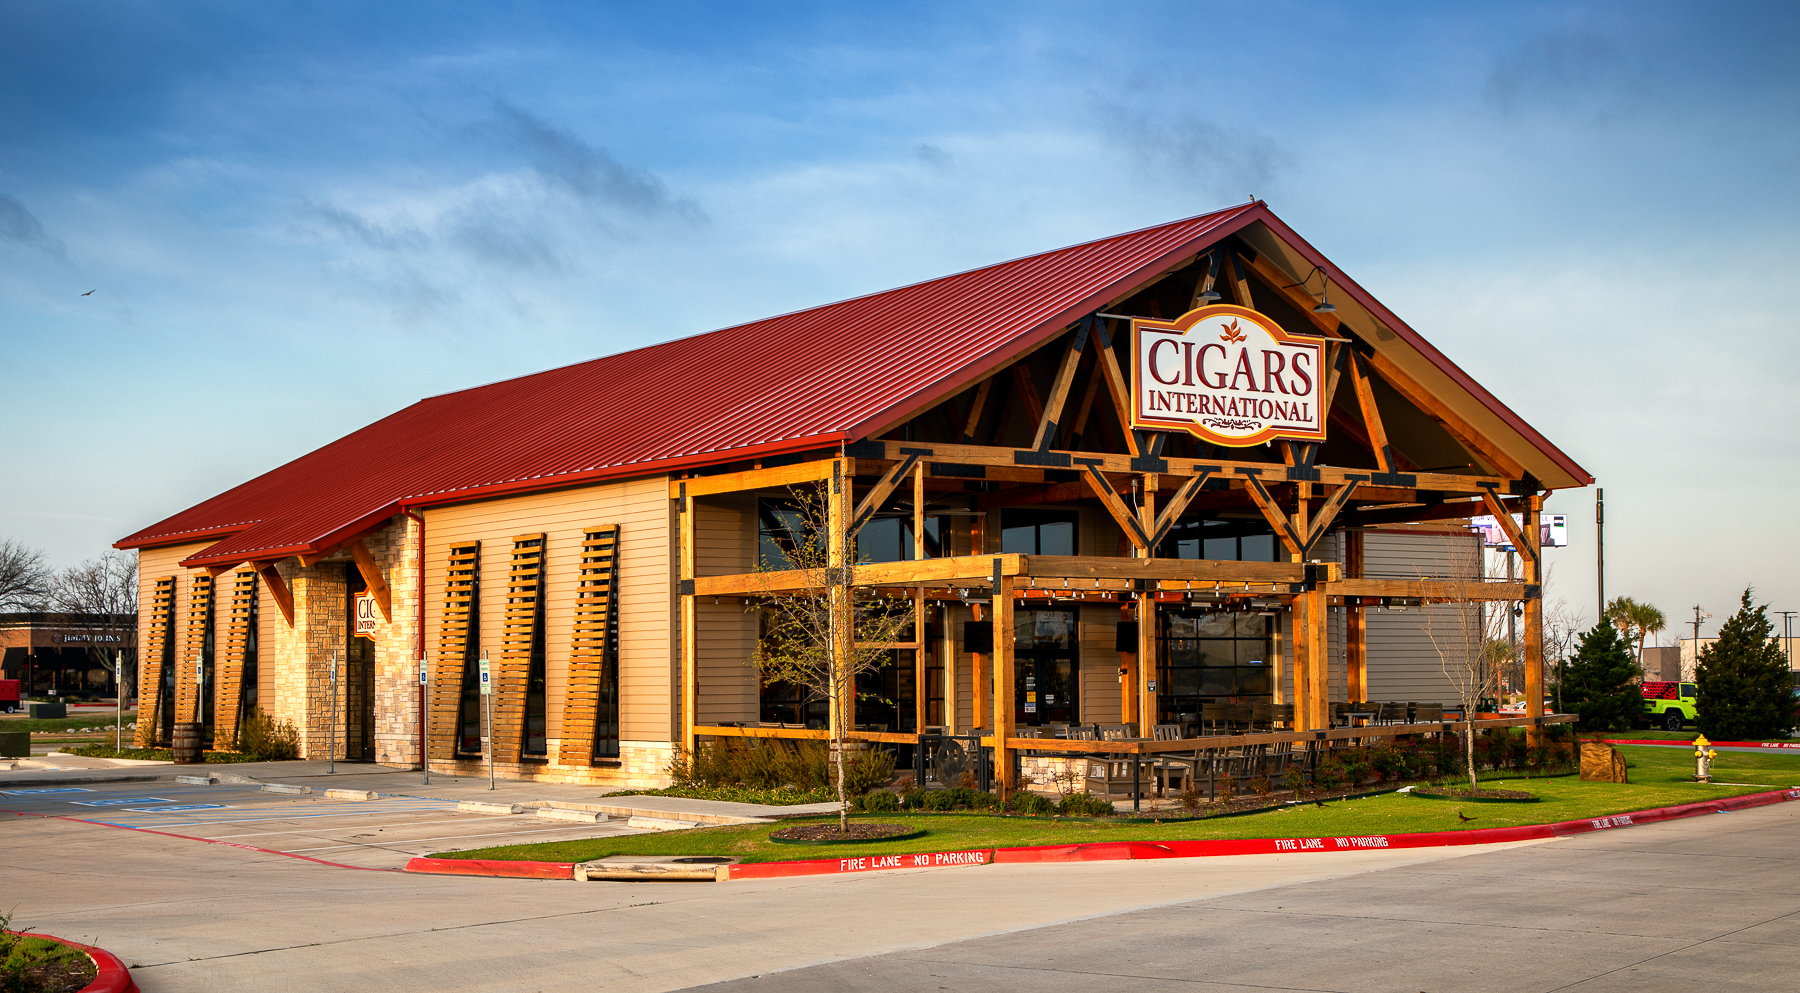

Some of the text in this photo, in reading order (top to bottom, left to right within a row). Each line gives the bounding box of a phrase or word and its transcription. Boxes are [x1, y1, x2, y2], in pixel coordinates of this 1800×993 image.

[1148, 338, 1312, 397] CIGARS
[1148, 389, 1313, 423] INTERNATIONAL
[1275, 836, 1389, 850] FIRE LANE NO PARKING
[840, 851, 984, 871] FIRE LANE NO PARKING
